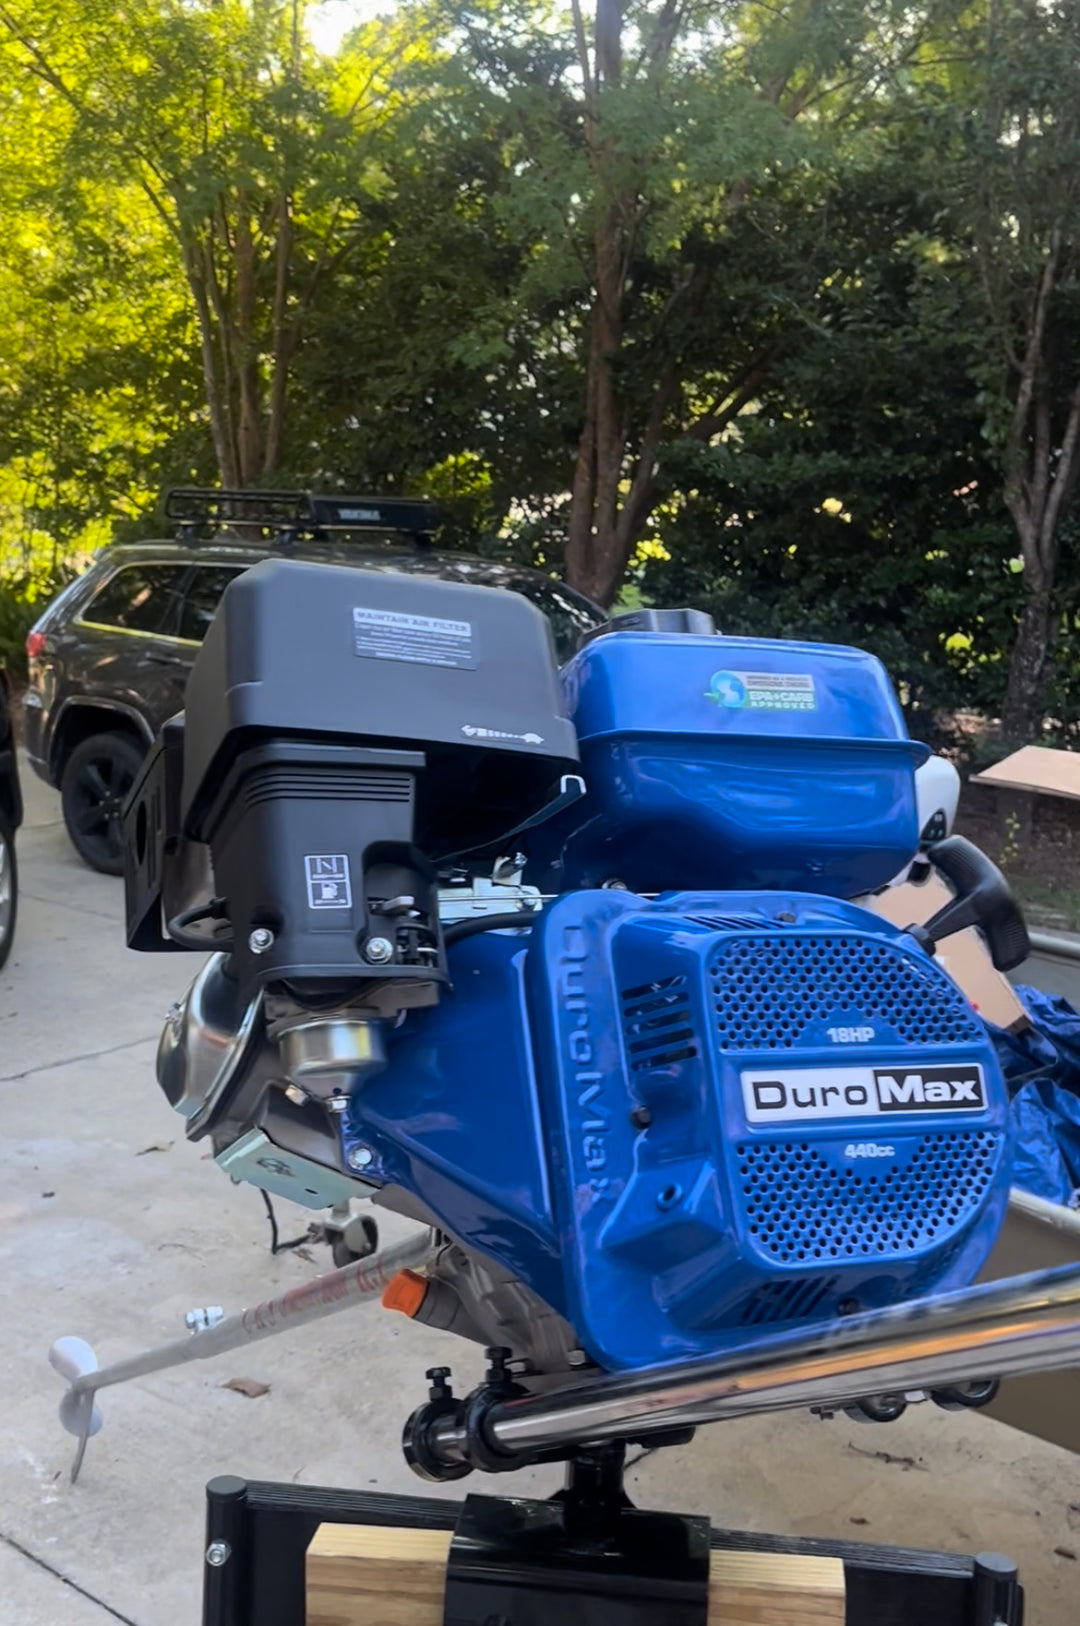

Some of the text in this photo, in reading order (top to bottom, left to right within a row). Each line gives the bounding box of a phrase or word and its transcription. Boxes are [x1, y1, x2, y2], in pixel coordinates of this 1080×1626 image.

[357, 610, 410, 624] MAINTAIN
[412, 618, 431, 629] AIR
[433, 621, 468, 633] FILTER
[827, 1027, 875, 1043] 18HP
[844, 1142, 896, 1159] 440cc
